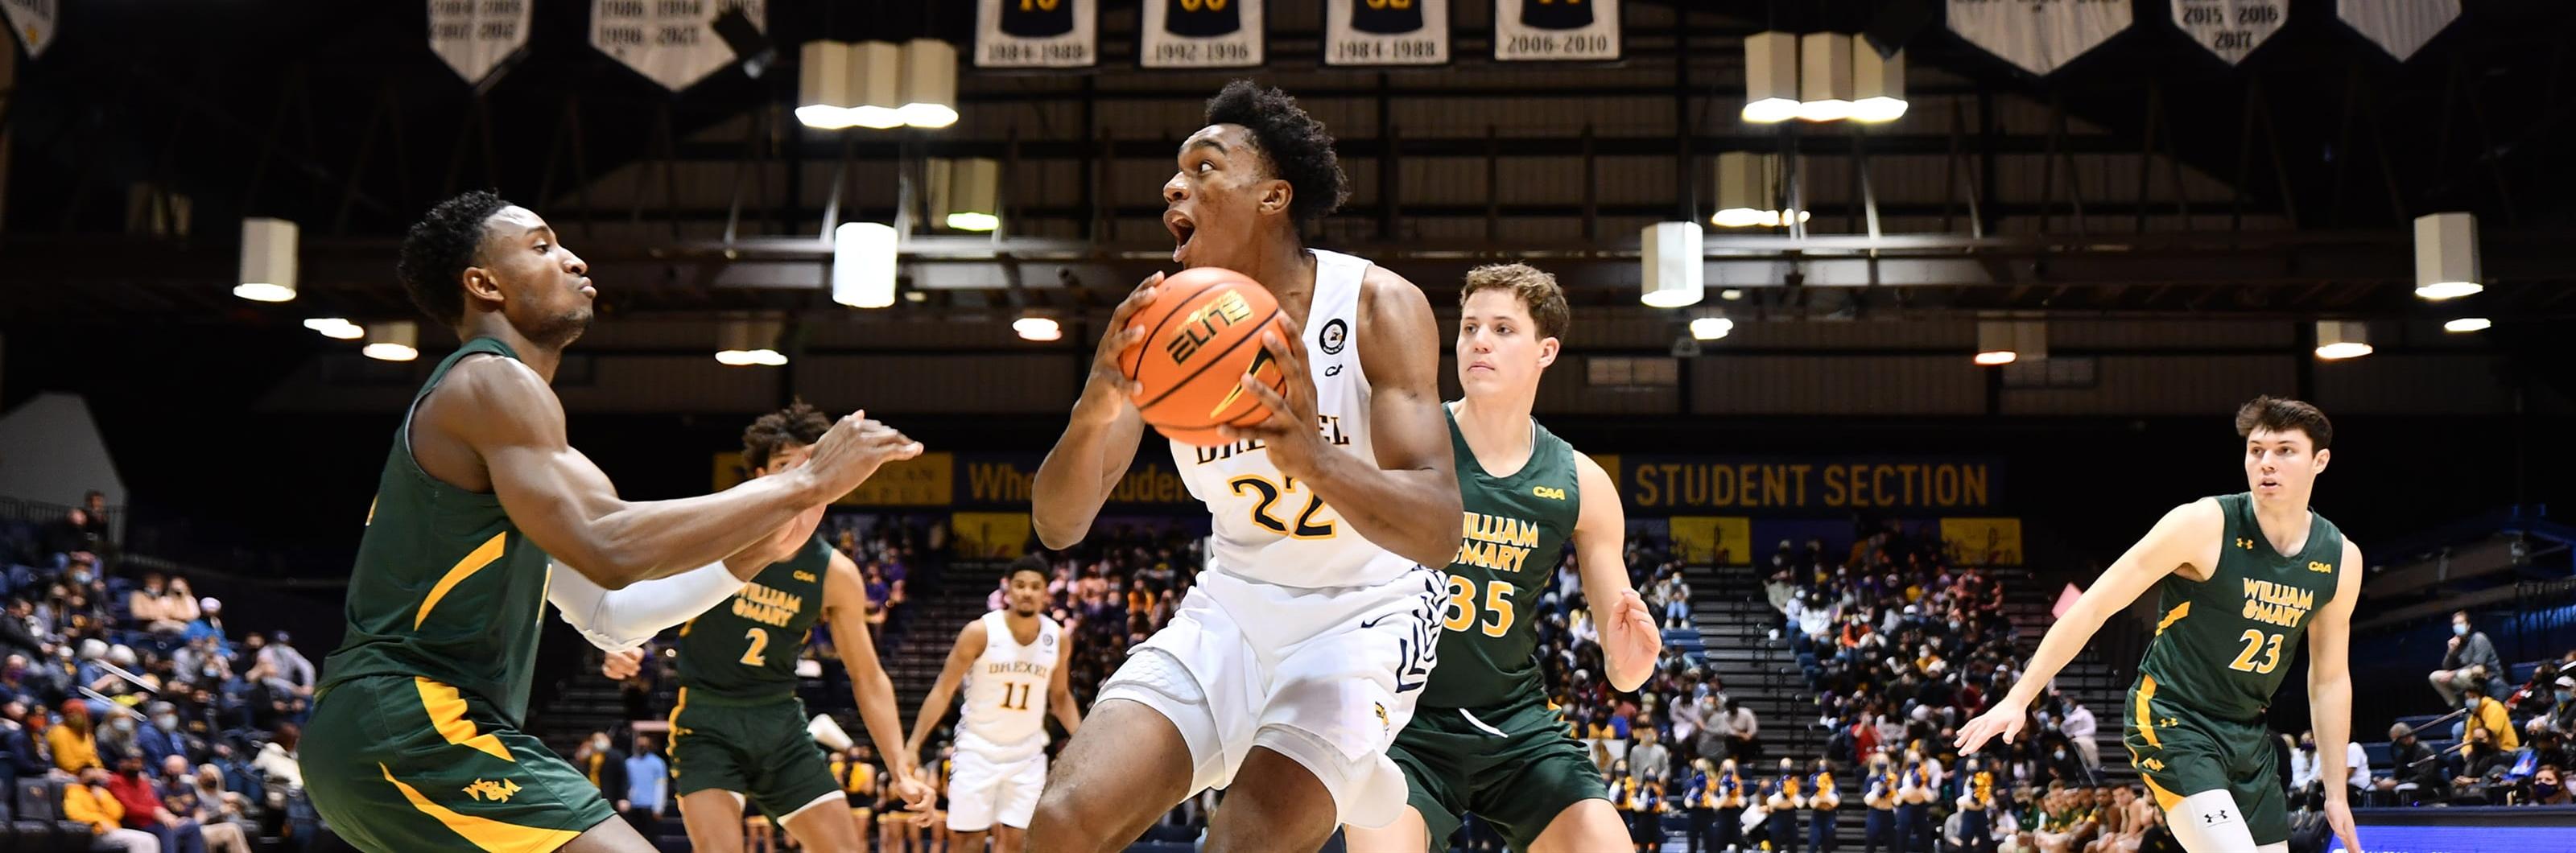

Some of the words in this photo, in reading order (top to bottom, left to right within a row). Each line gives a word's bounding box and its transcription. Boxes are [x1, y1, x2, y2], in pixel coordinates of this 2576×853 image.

[2183, 6, 2223, 24] 2015
[2239, 6, 2278, 24] 2016
[988, 43, 1085, 60] 1984-1988
[1156, 43, 1249, 61] 1992-1996
[1339, 40, 1435, 59] 1984-1988
[1508, 35, 1607, 53] 2006-2010
[2215, 31, 2252, 50] 2017
[1166, 290, 1252, 365] ELITE
[1533, 486, 1566, 501] CAA
[1635, 464, 1811, 507] STUDENT
[1823, 464, 1988, 507] SECTION
[1227, 474, 1337, 540] 22
[1463, 511, 1538, 548] ILLIAM
[2308, 561, 2331, 574] CAA
[2243, 577, 2314, 610] WILLIAM
[1443, 575, 1514, 637] 35
[739, 627, 769, 666] 2
[2228, 628, 2284, 674] 23
[989, 660, 1047, 678] DREXEL
[1000, 682, 1030, 710] 11
